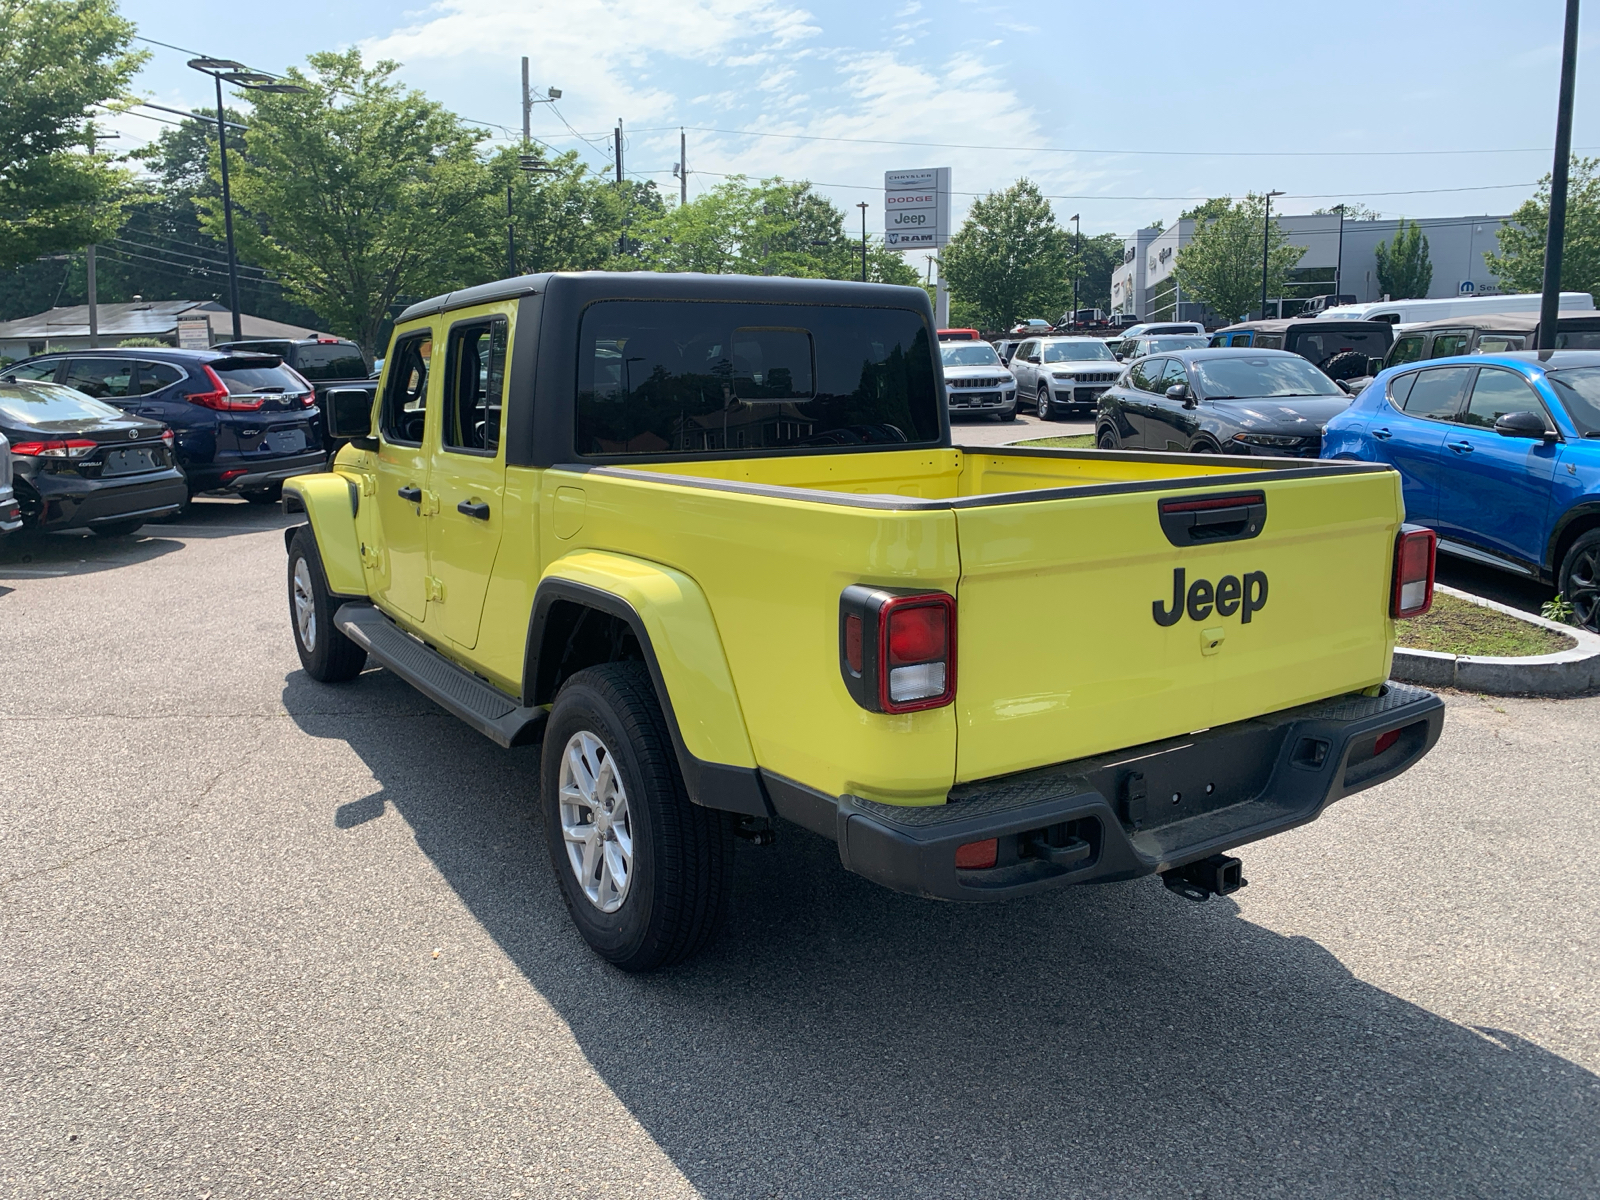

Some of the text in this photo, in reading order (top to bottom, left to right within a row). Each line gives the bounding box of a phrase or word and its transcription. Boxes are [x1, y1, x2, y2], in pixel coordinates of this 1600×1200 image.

[888, 195, 933, 204] DODGE
[894, 213, 926, 226] Jeep
[1153, 567, 1269, 627] Jeep
